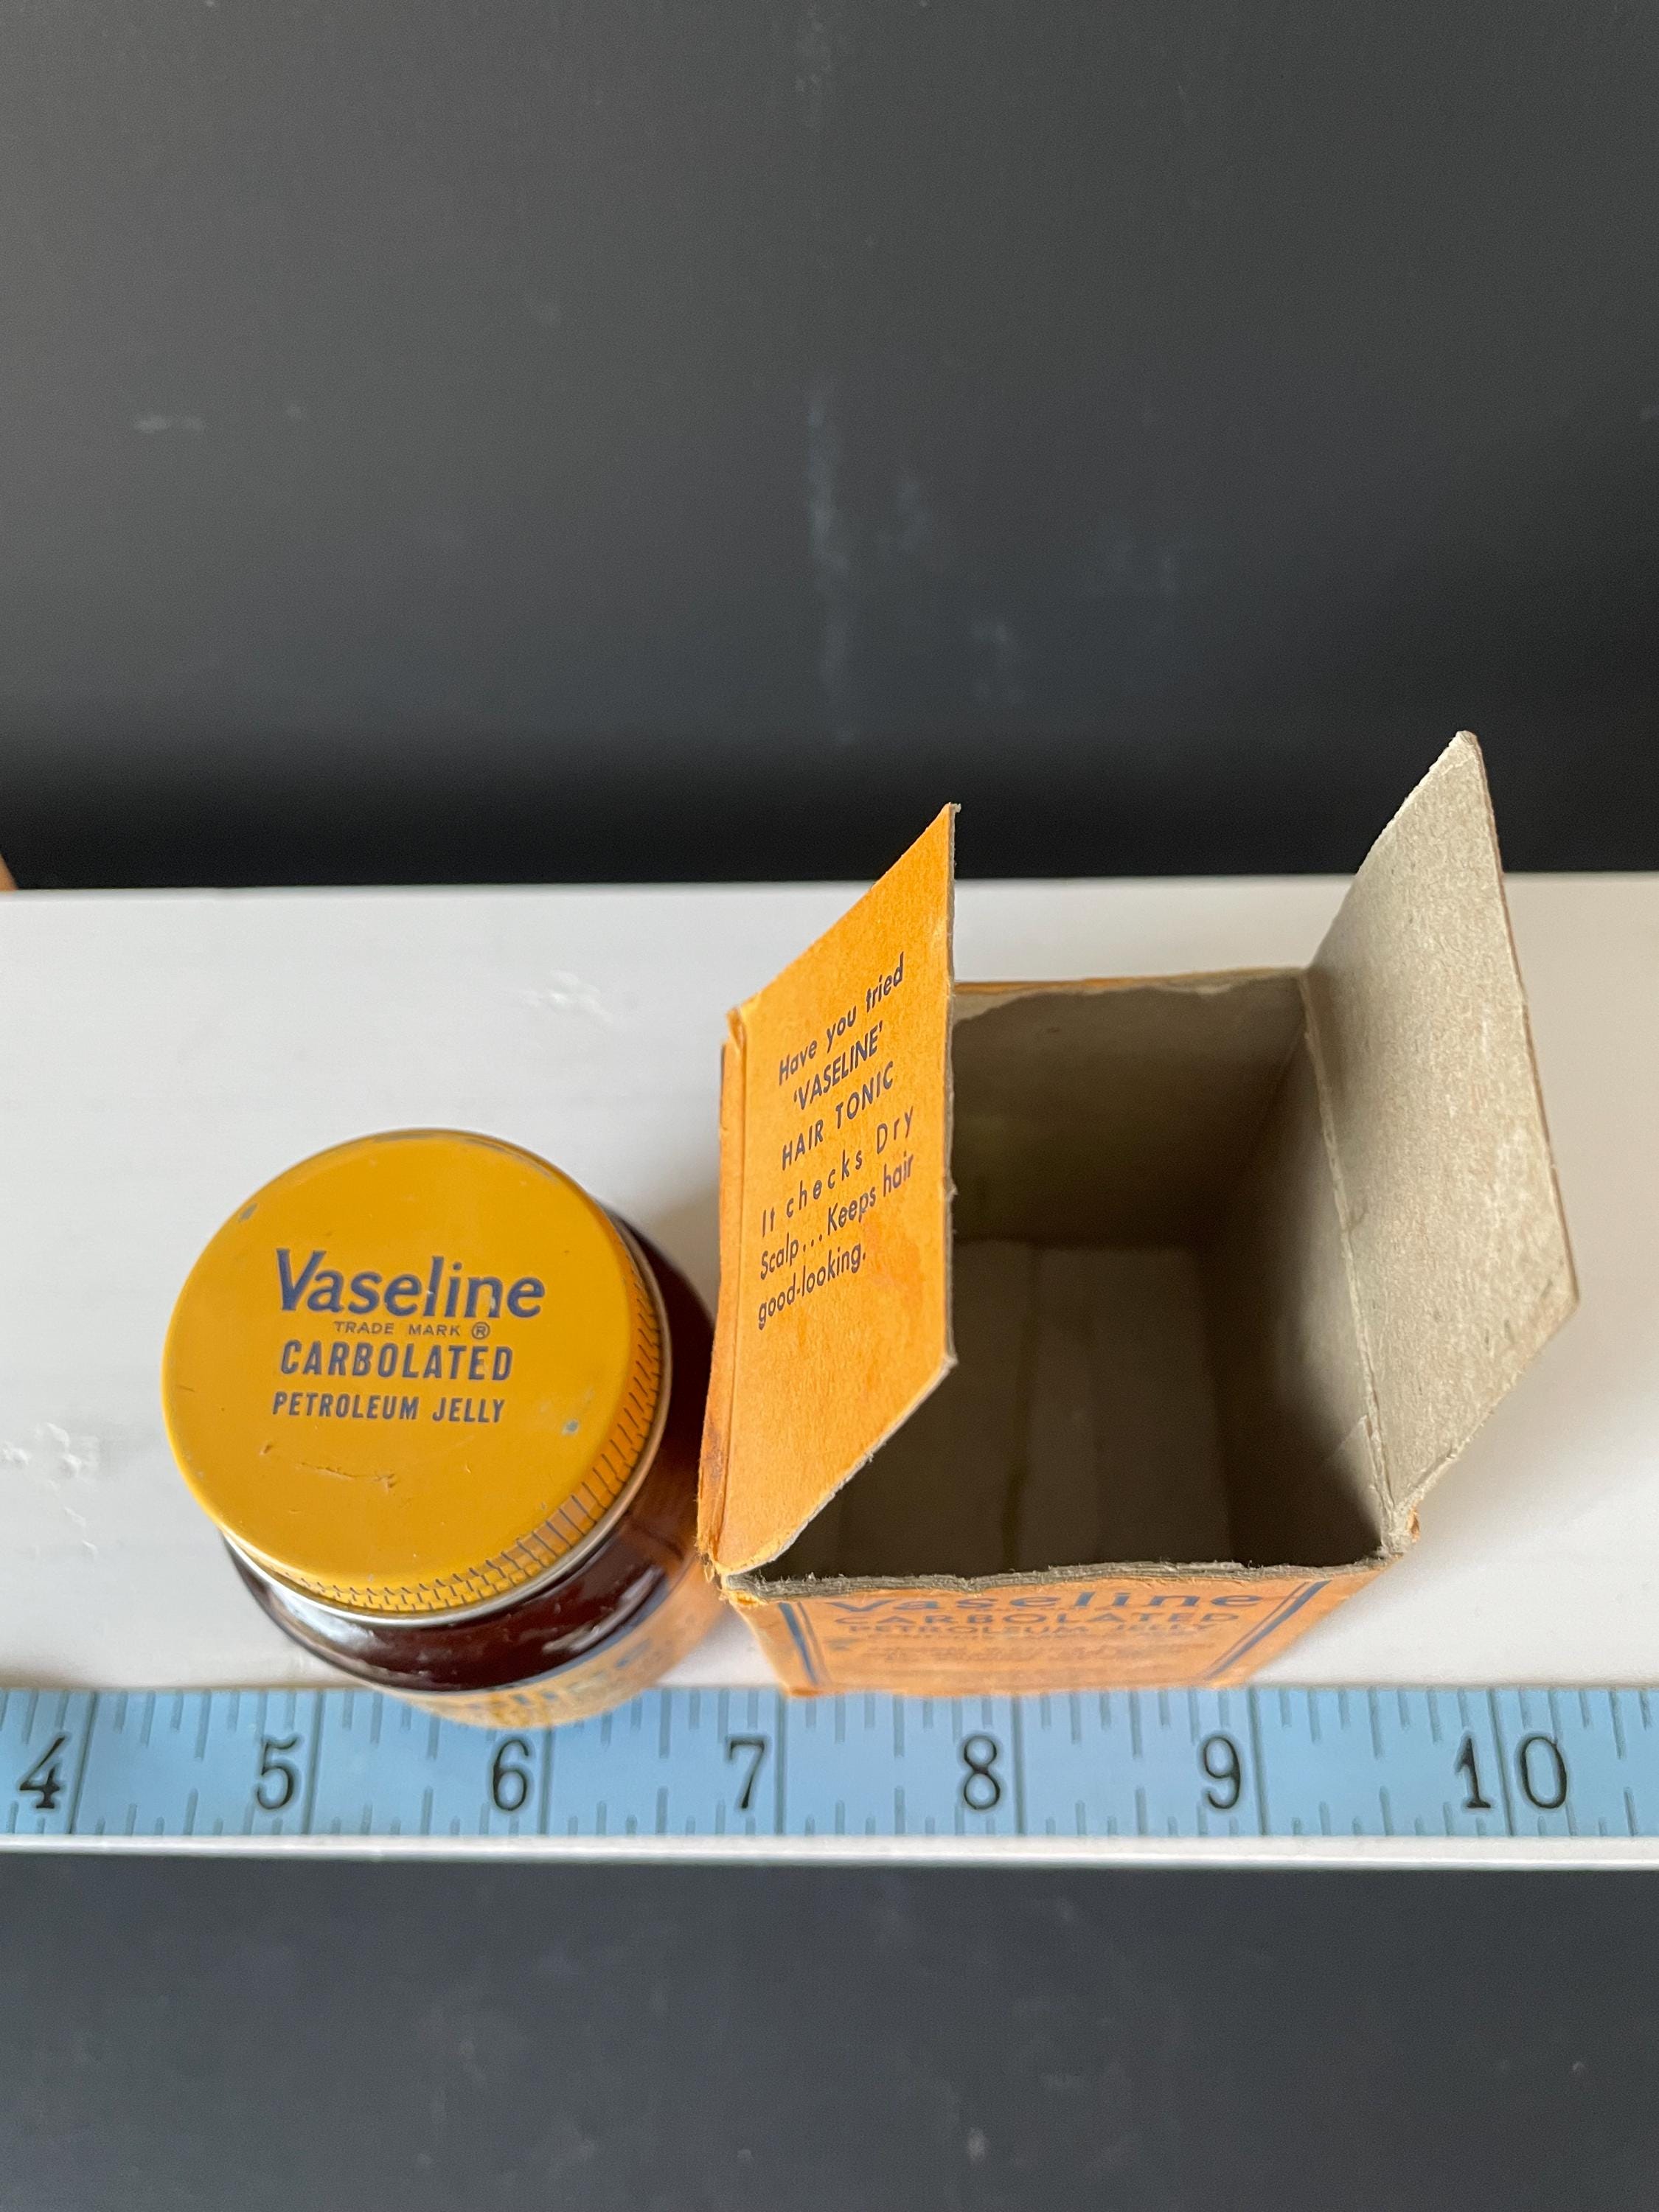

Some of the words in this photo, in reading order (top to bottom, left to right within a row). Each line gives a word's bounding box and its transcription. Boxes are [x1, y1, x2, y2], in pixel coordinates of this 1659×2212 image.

[779, 1042, 817, 1085] Have
[826, 1006, 856, 1053] you
[866, 952, 904, 1012] tried
[782, 1119, 823, 1170] HAIR
[836, 1061, 894, 1130] TONIC
[762, 1209, 775, 1237] It
[786, 1147, 863, 1219] checks
[876, 1107, 914, 1155] Dry
[883, 1153, 914, 1197] hair
[276, 1248, 546, 1318] Vaseline
[758, 1242, 866, 1330] good-looking.
[333, 1321, 394, 1335] TRADE
[408, 1324, 461, 1337] MARK
[280, 1339, 513, 1381] CARBOLATED
[272, 1391, 419, 1420] PETROLEUM
[432, 1398, 505, 1423] JELLY
[826, 1591, 1262, 1612] Vaseline
[835, 1612, 1239, 1624] CARBOLATED
[18, 1734, 69, 1811] 4
[254, 1734, 301, 1811] 5
[491, 1737, 534, 1812] 6
[726, 1736, 765, 1809] 7
[961, 1734, 1001, 1811] 8
[1202, 1734, 1242, 1809] 9
[1453, 1731, 1569, 1810] 10
